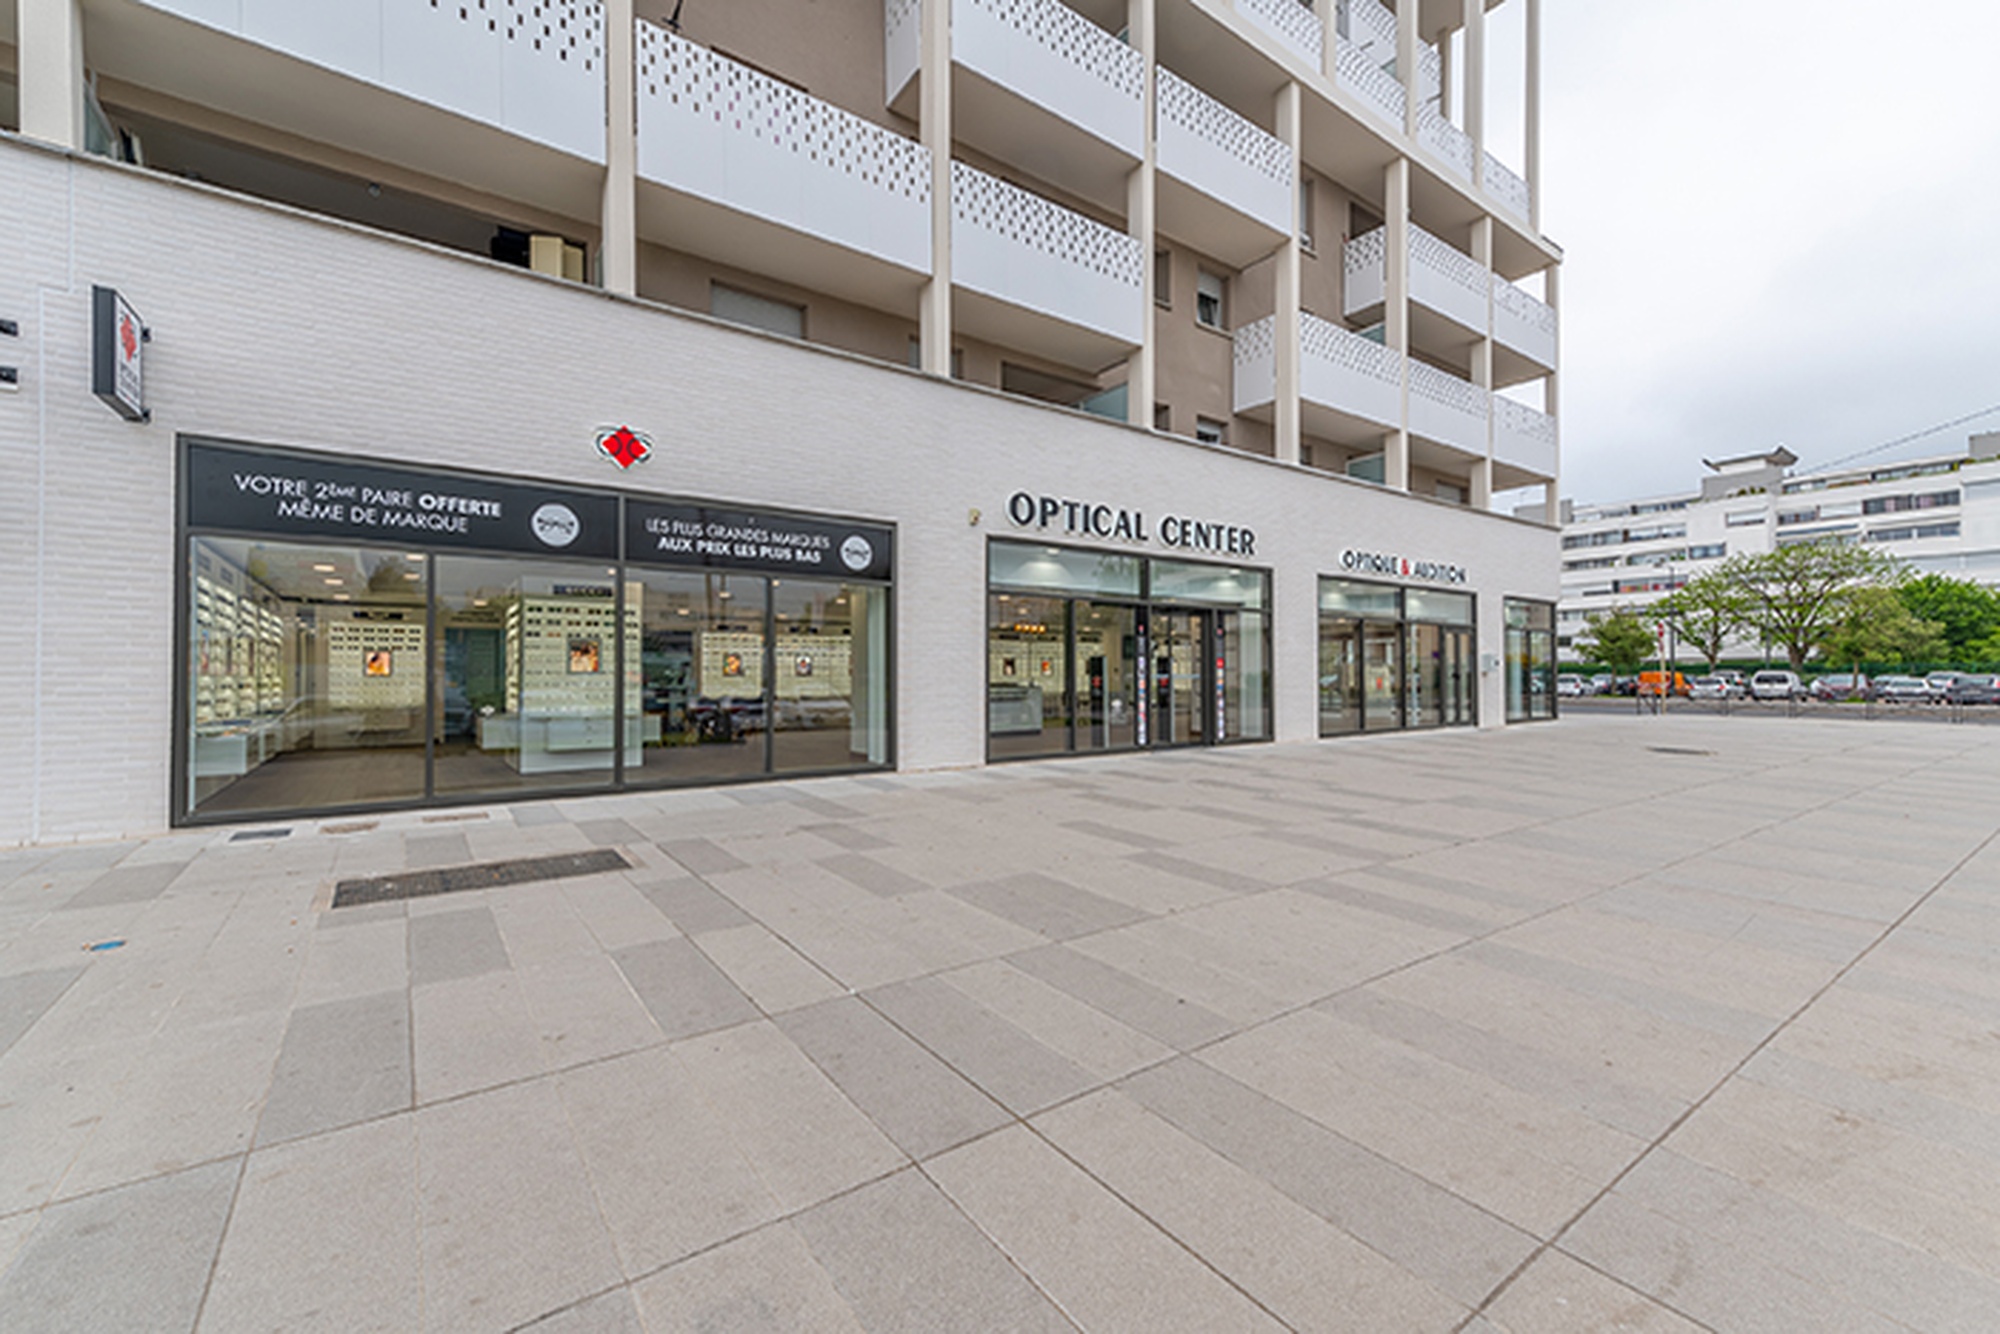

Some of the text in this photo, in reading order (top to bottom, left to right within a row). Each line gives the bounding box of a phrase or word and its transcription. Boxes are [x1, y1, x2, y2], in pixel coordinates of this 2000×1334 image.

[234, 473, 307, 497] VOTRE
[362, 487, 412, 508] PAIRE
[419, 493, 501, 517] OFFERTE
[278, 498, 468, 533] MÊME DE MARQUE
[646, 518, 670, 533] LES
[673, 520, 703, 537] PLUS
[706, 523, 769, 543] GRANDES
[1009, 491, 1256, 555] OPTICAL CENTER
[658, 536, 822, 563] AUX PRIX LES PLUS BAS
[1342, 550, 1397, 575] OPTIQUE
[1414, 561, 1467, 582] AUDITION
